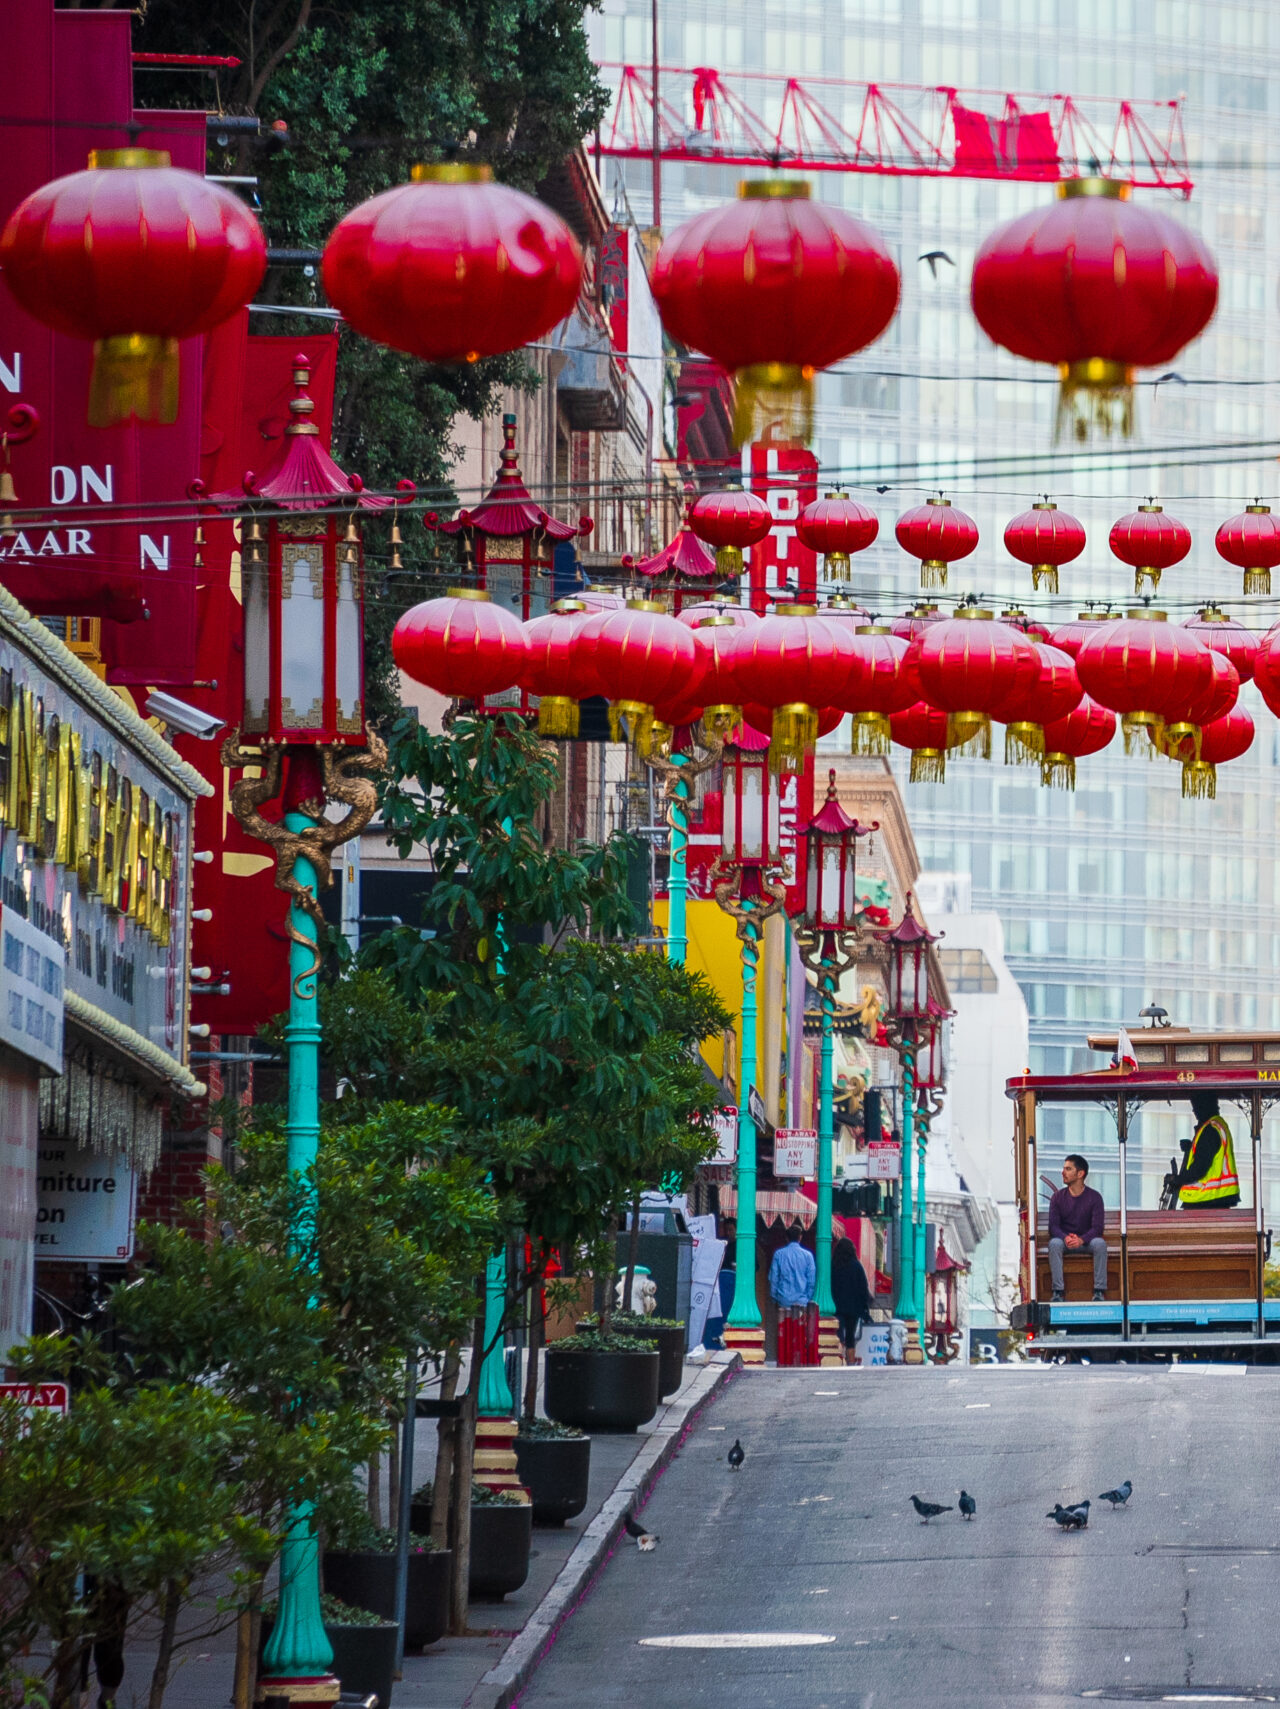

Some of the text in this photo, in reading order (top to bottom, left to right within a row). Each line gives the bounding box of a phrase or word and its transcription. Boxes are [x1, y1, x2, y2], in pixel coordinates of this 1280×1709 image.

[0, 528, 95, 558] AAR
[1176, 1071, 1196, 1083] 49
[786, 1160, 804, 1168] TIME
[703, 1167, 732, 1181] SALE
